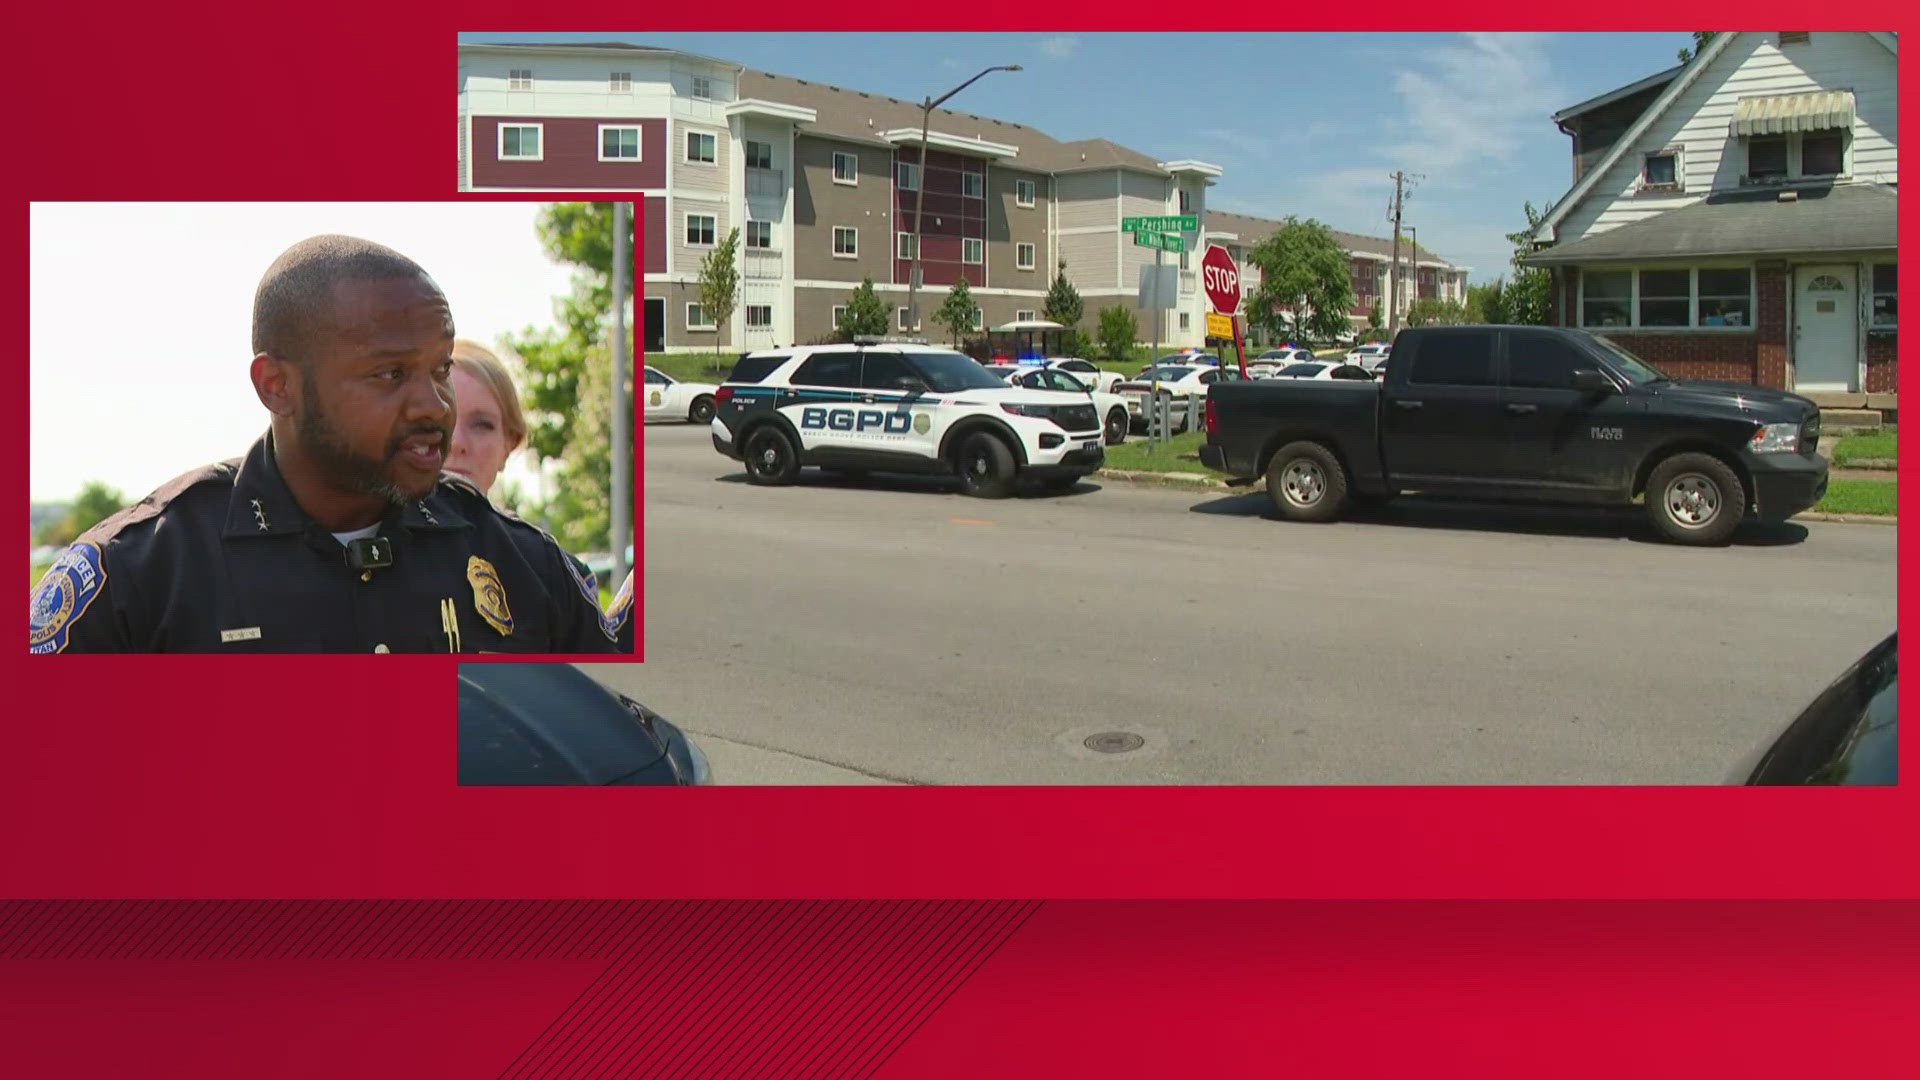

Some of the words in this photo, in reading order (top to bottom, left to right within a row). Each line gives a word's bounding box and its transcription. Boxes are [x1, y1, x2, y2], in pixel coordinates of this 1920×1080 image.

[1141, 218, 1182, 232] Pershing
[1205, 264, 1237, 295] STOP
[801, 407, 912, 434] BGPD
[61, 578, 73, 616] COUNTY
